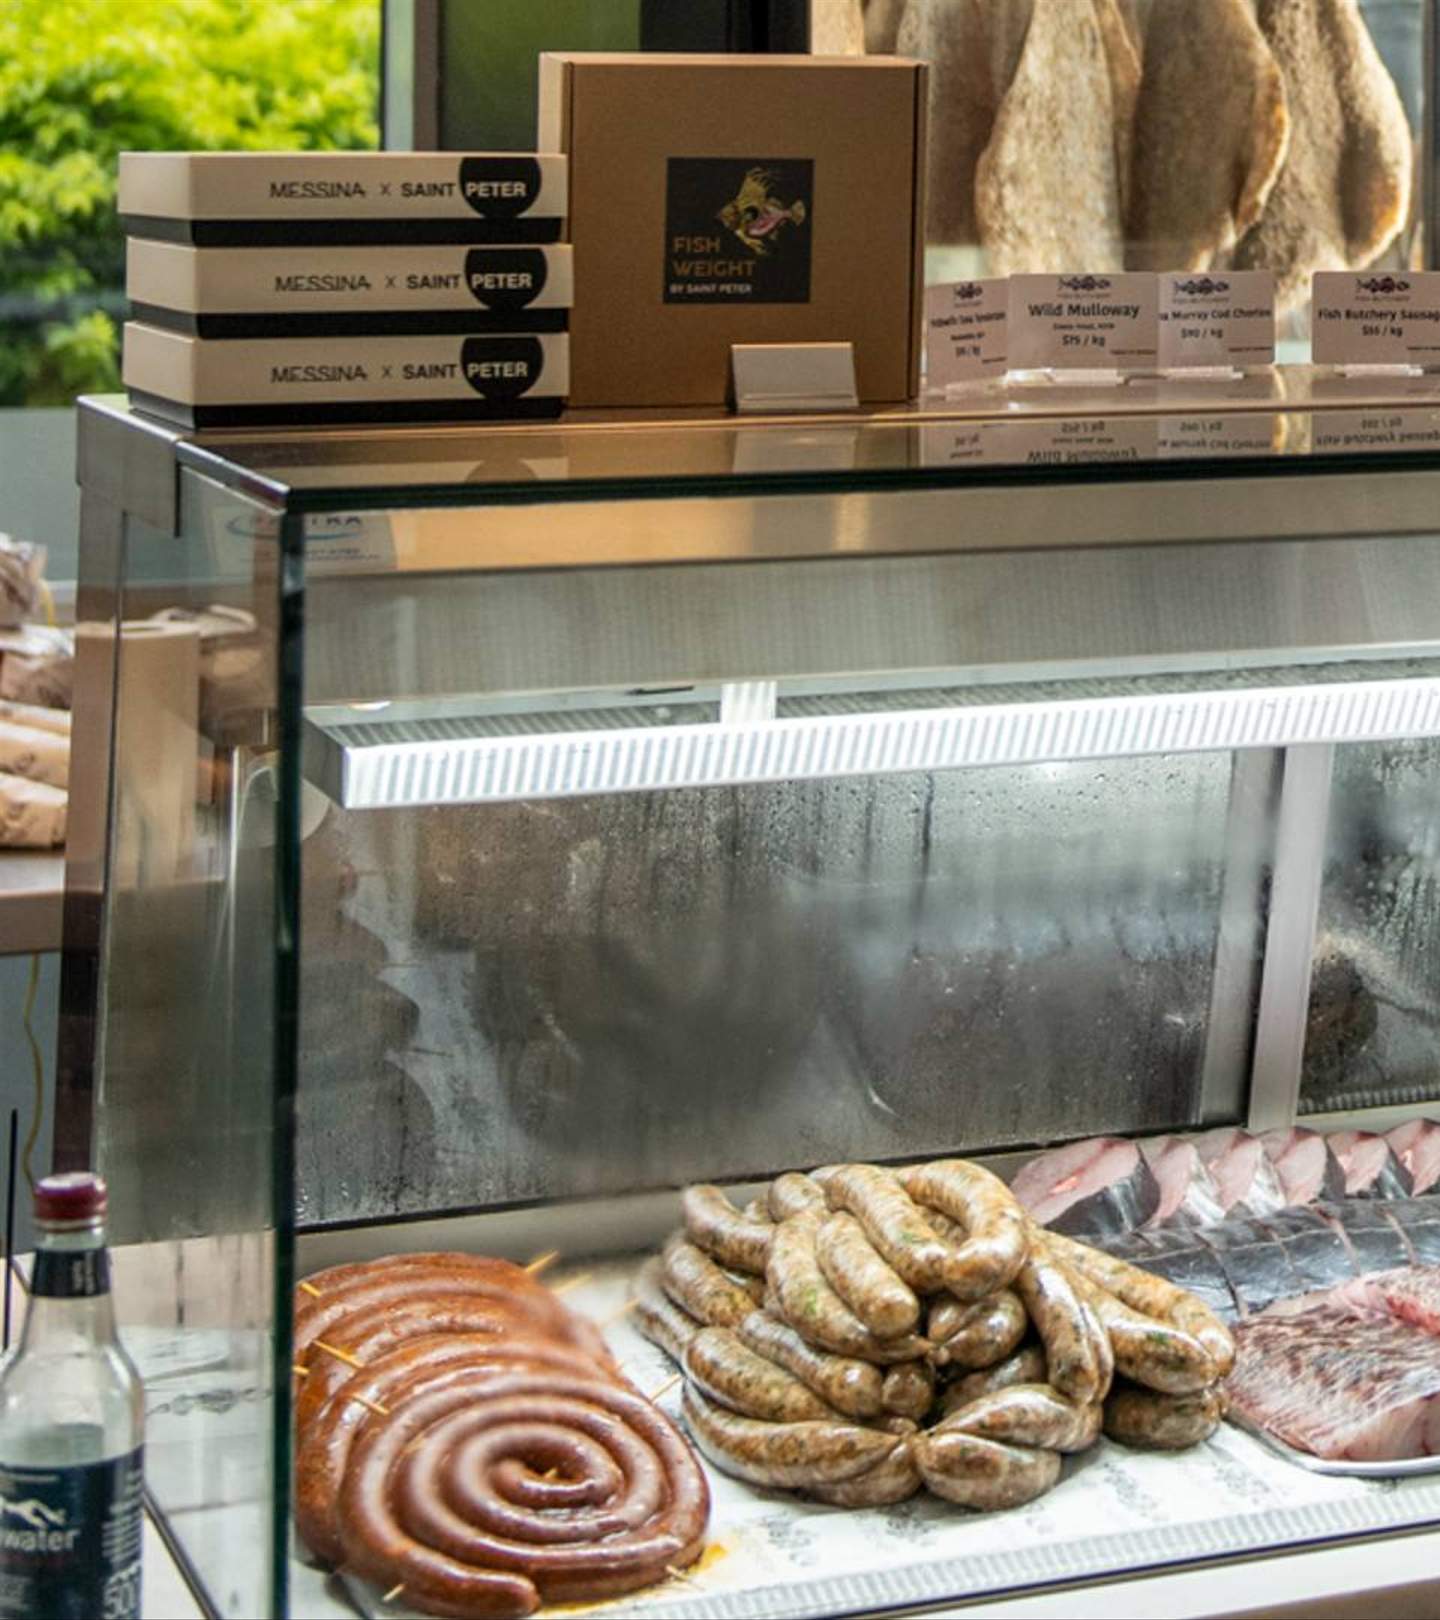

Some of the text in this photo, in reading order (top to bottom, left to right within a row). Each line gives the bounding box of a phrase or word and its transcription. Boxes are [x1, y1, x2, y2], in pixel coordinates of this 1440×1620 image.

[269, 181, 366, 199] MESSINA
[400, 181, 456, 198] SAINT
[465, 180, 527, 198] PETER
[673, 236, 721, 254] FISH
[672, 260, 757, 278] WEIGHT
[274, 274, 371, 292] MESSINA
[406, 273, 461, 290] SAINT
[470, 272, 533, 289] PETER
[1028, 303, 1140, 319] Wild Mulloway
[1318, 308, 1342, 320] Fish
[1345, 308, 1398, 322] Butchery
[270, 365, 367, 383] MESSINA
[402, 363, 457, 380] SAINT
[467, 362, 529, 379] PETER
